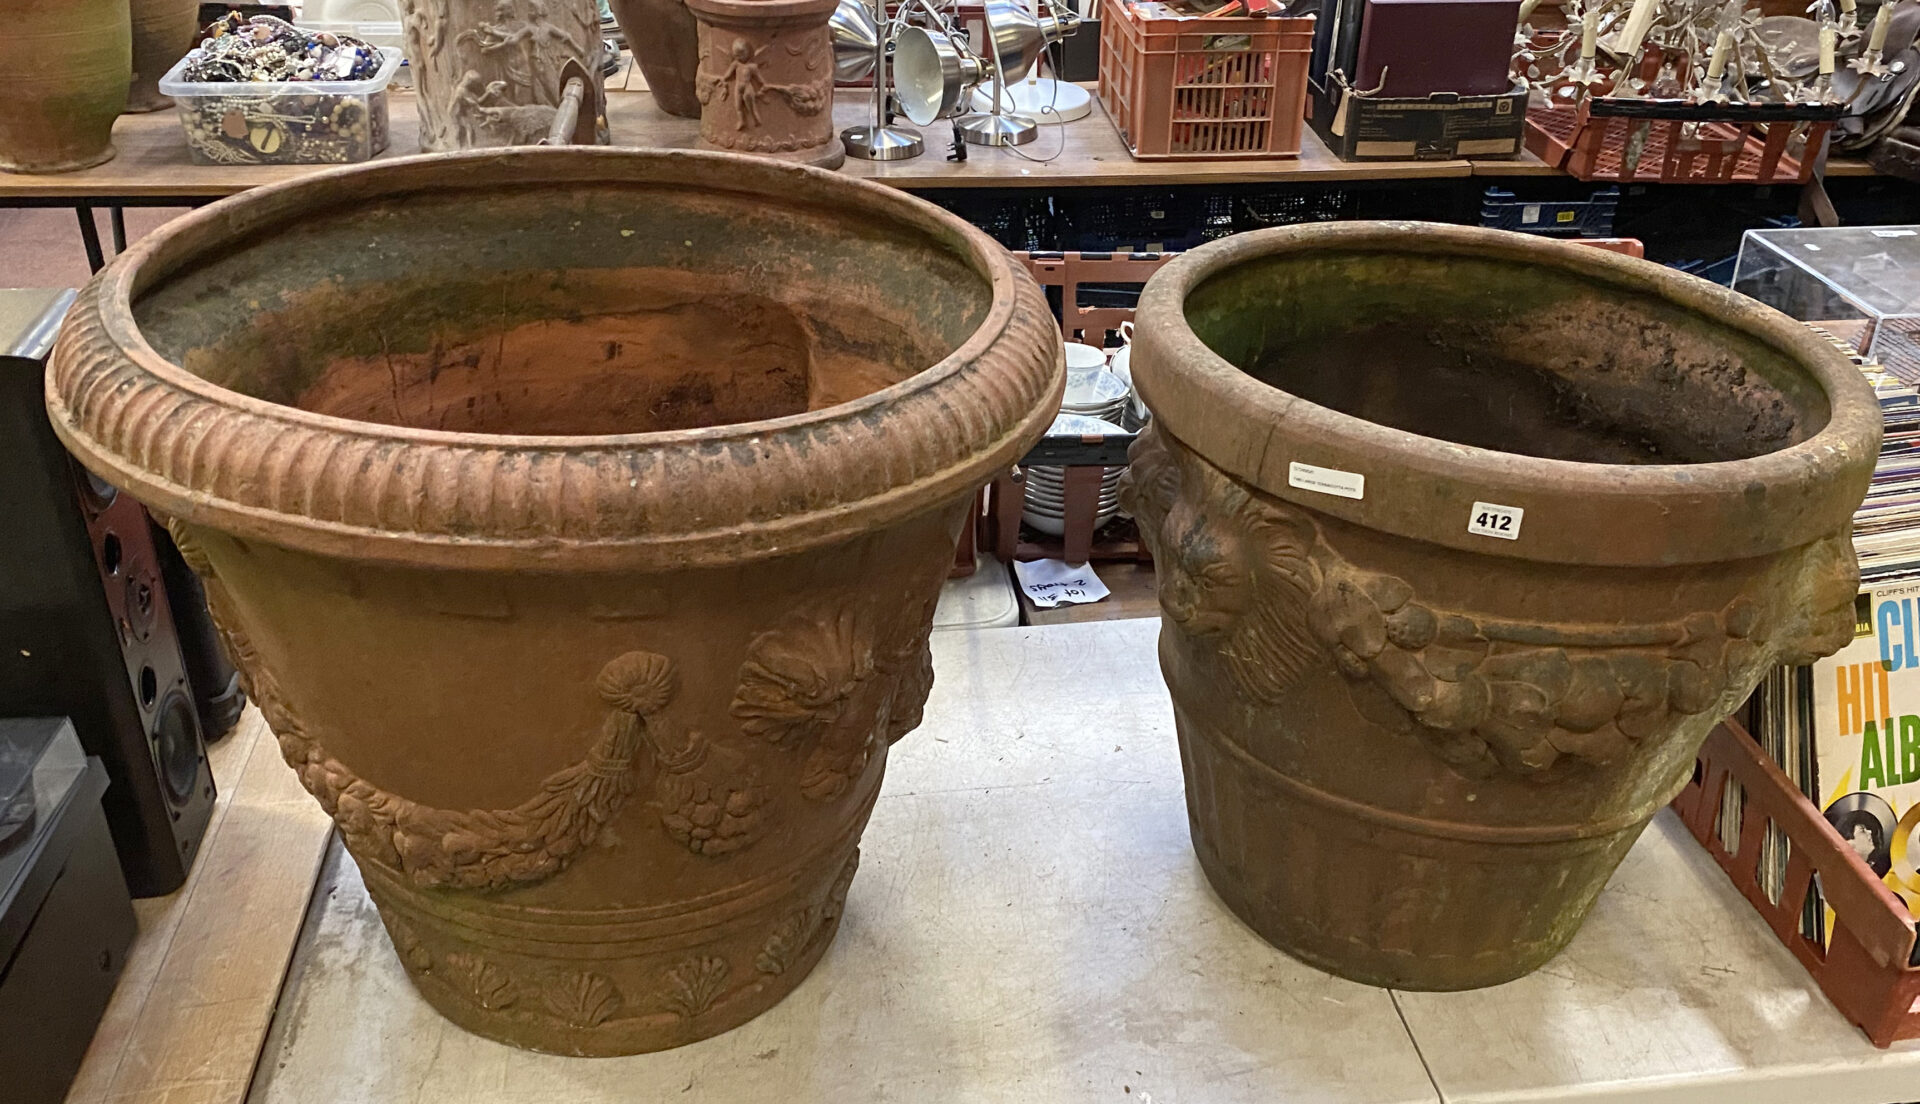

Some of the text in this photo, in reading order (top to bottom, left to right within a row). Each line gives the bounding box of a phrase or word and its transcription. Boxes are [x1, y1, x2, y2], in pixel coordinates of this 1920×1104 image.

[1476, 512, 1512, 531] 412
[1876, 585, 1920, 597] CLIFF'S HIT
[1877, 597, 1920, 672] CL
[1836, 661, 1890, 736] HIT
